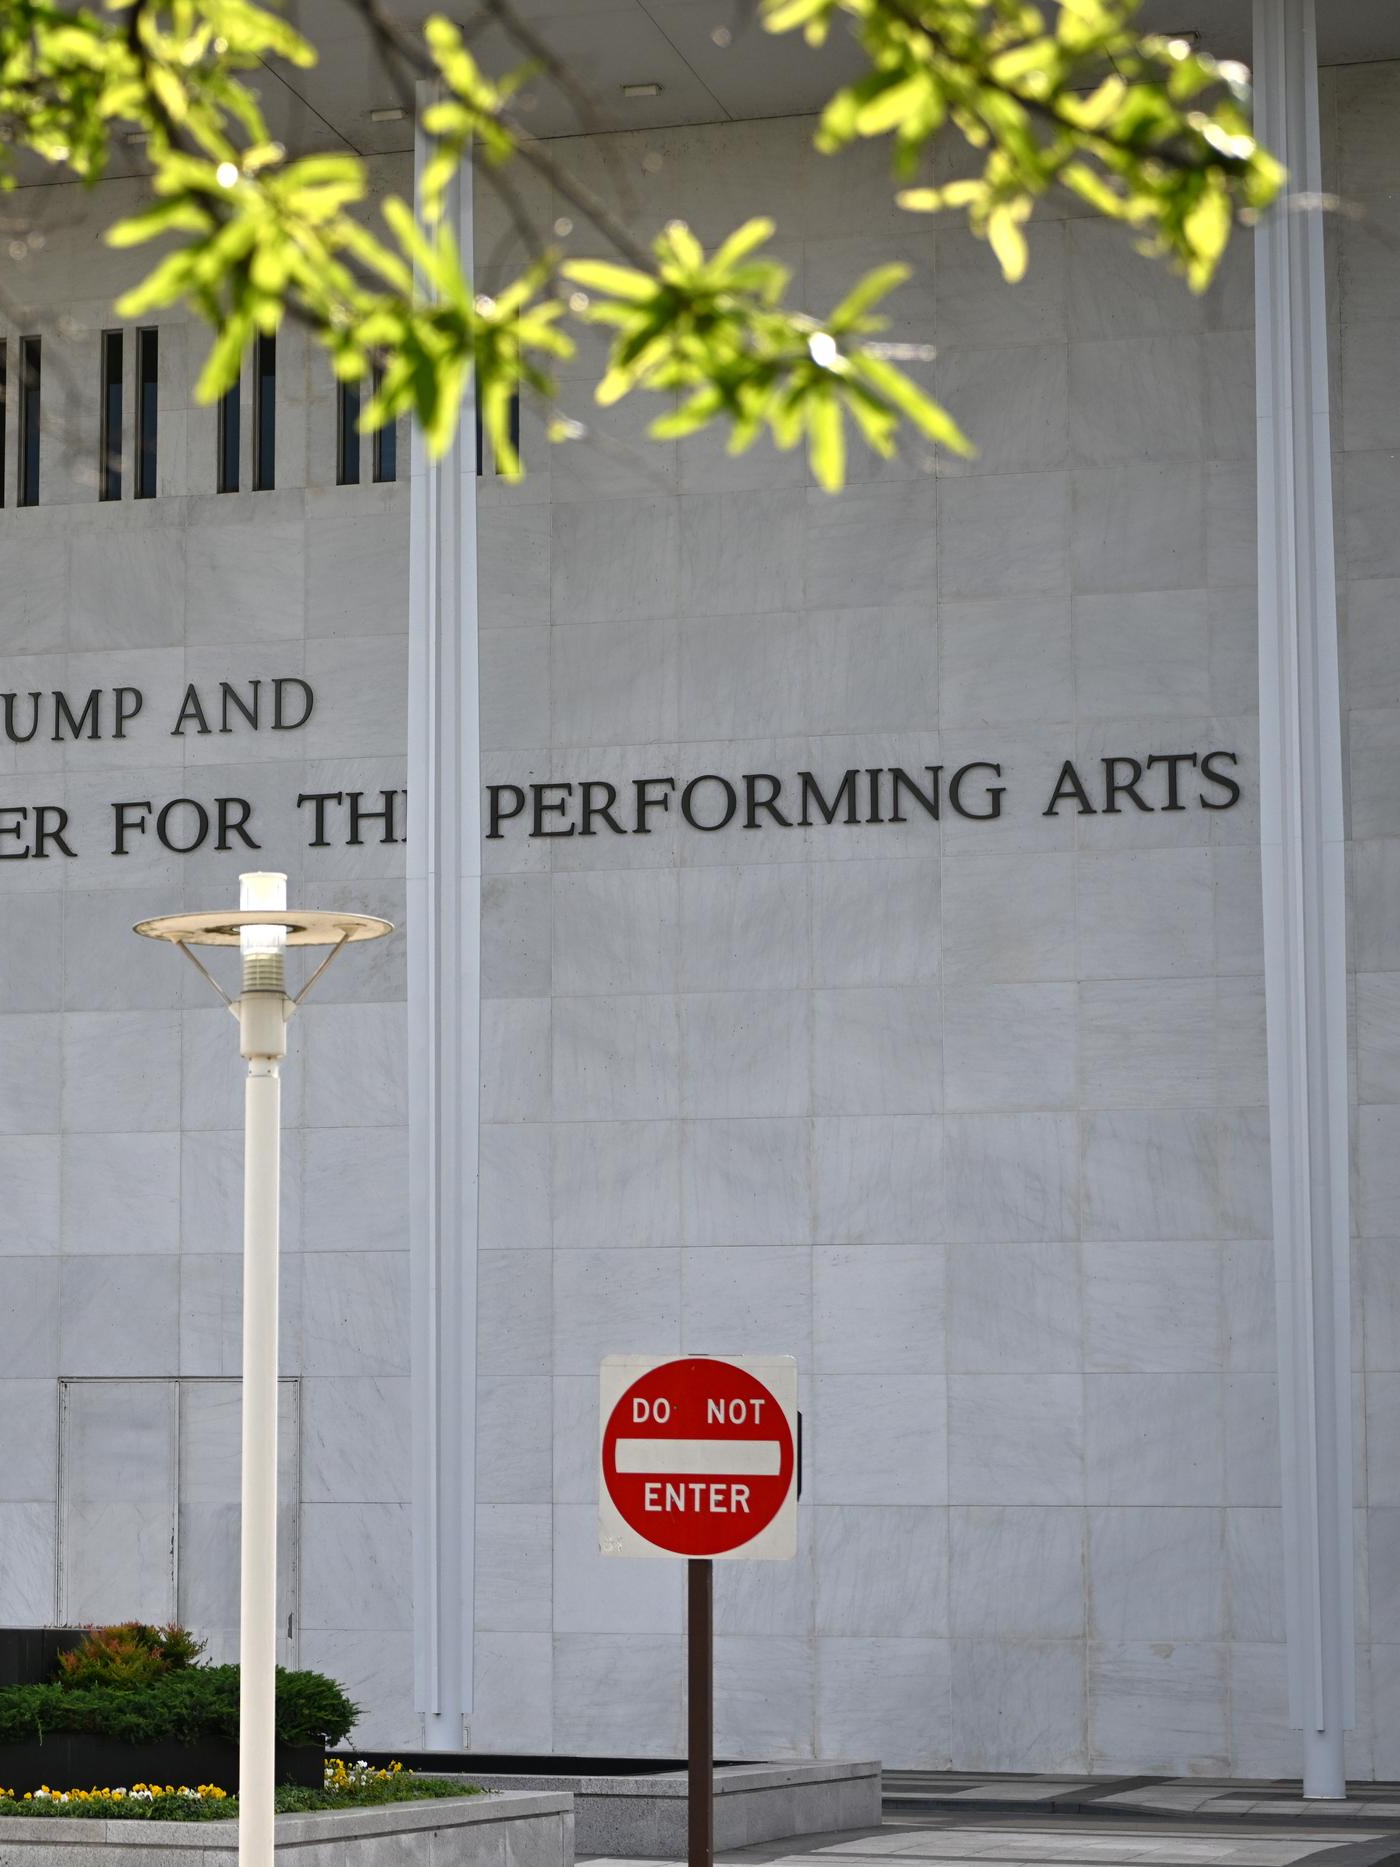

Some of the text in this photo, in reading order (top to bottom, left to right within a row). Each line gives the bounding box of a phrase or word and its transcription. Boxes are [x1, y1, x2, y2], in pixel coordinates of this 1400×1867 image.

[170, 677, 315, 736] AND
[110, 797, 262, 856] FOR
[296, 789, 408, 848] TH
[485, 761, 1007, 840] PERFORMING
[1041, 750, 1242, 817] ARTS
[632, 1397, 766, 1425] DO NOT
[644, 1482, 751, 1514] ENTER
